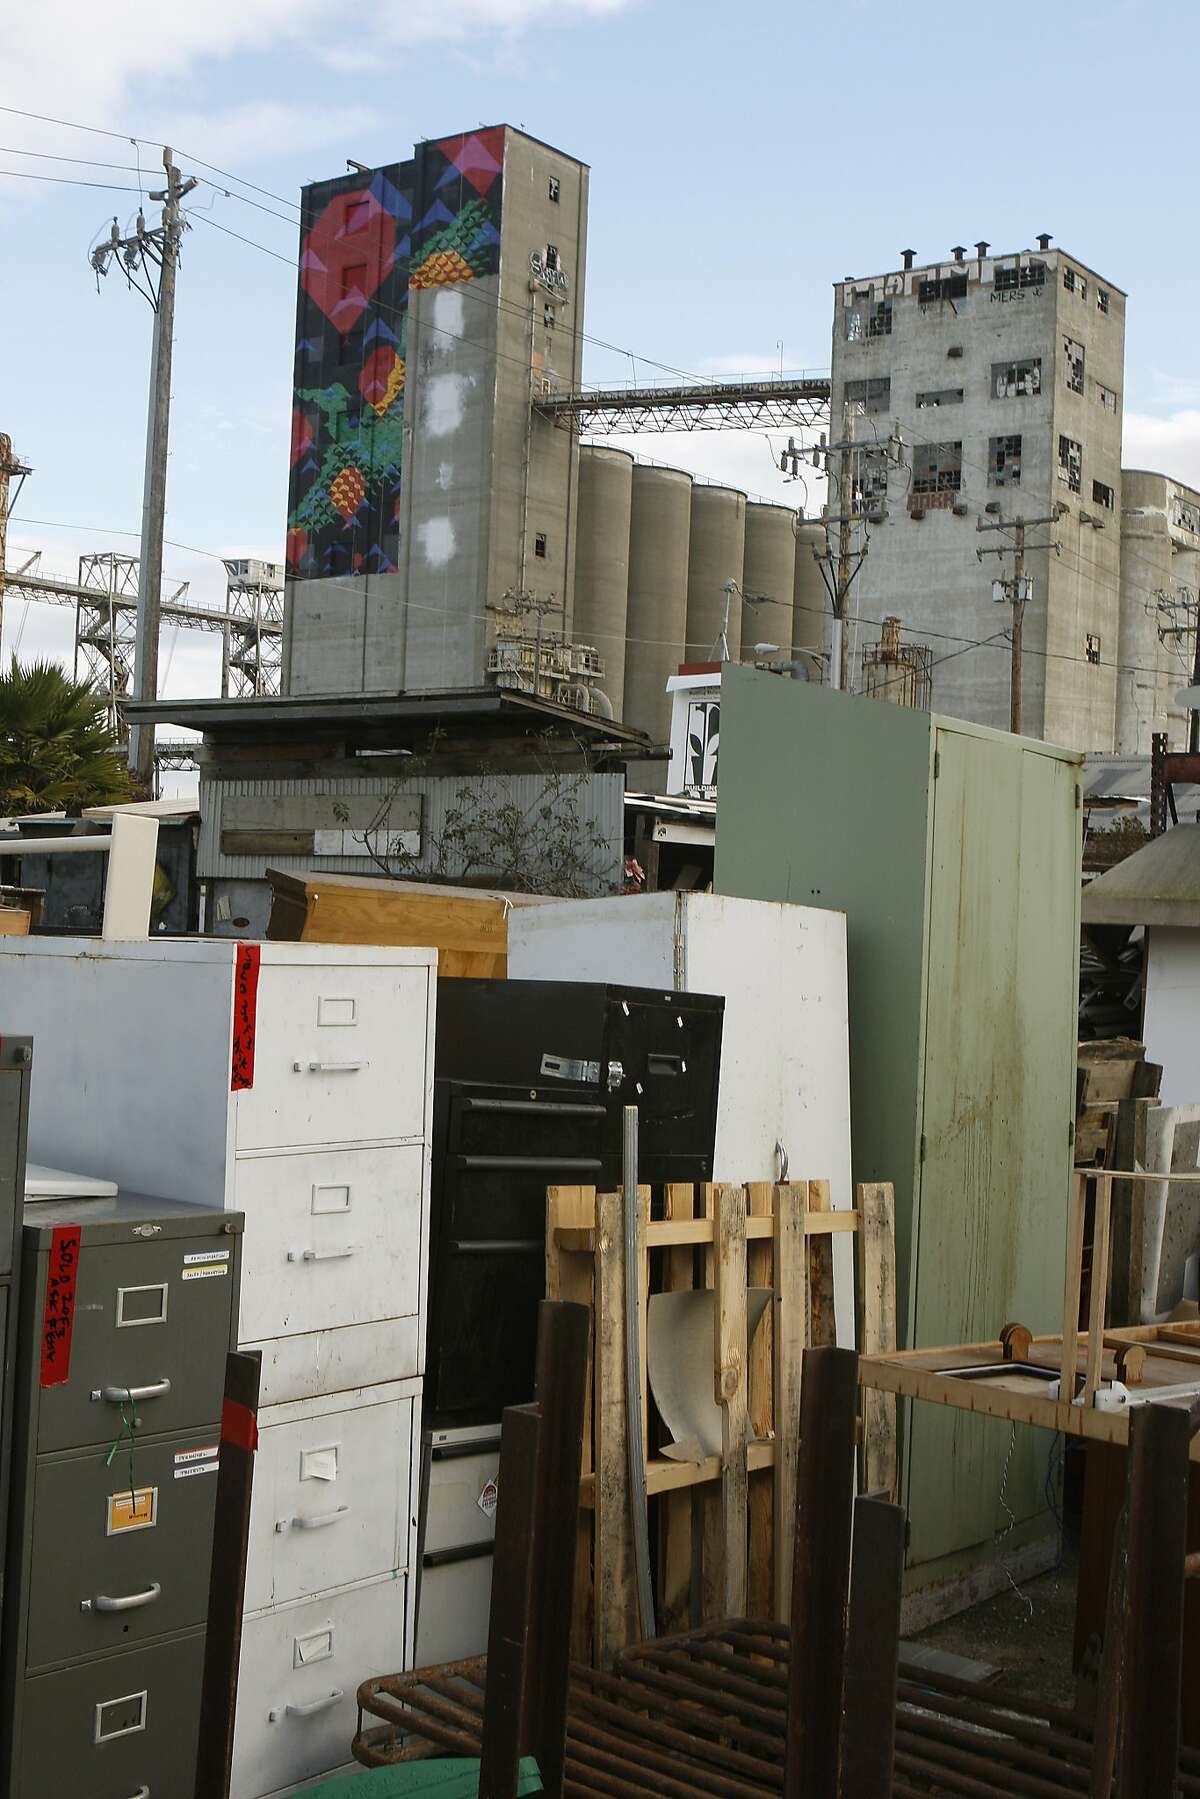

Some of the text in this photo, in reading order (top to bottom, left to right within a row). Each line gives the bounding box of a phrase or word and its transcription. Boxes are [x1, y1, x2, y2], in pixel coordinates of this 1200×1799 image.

[990, 289, 1025, 303] MERS
[59, 1239, 77, 1284] SOLD
[49, 1278, 60, 1312] ASK
